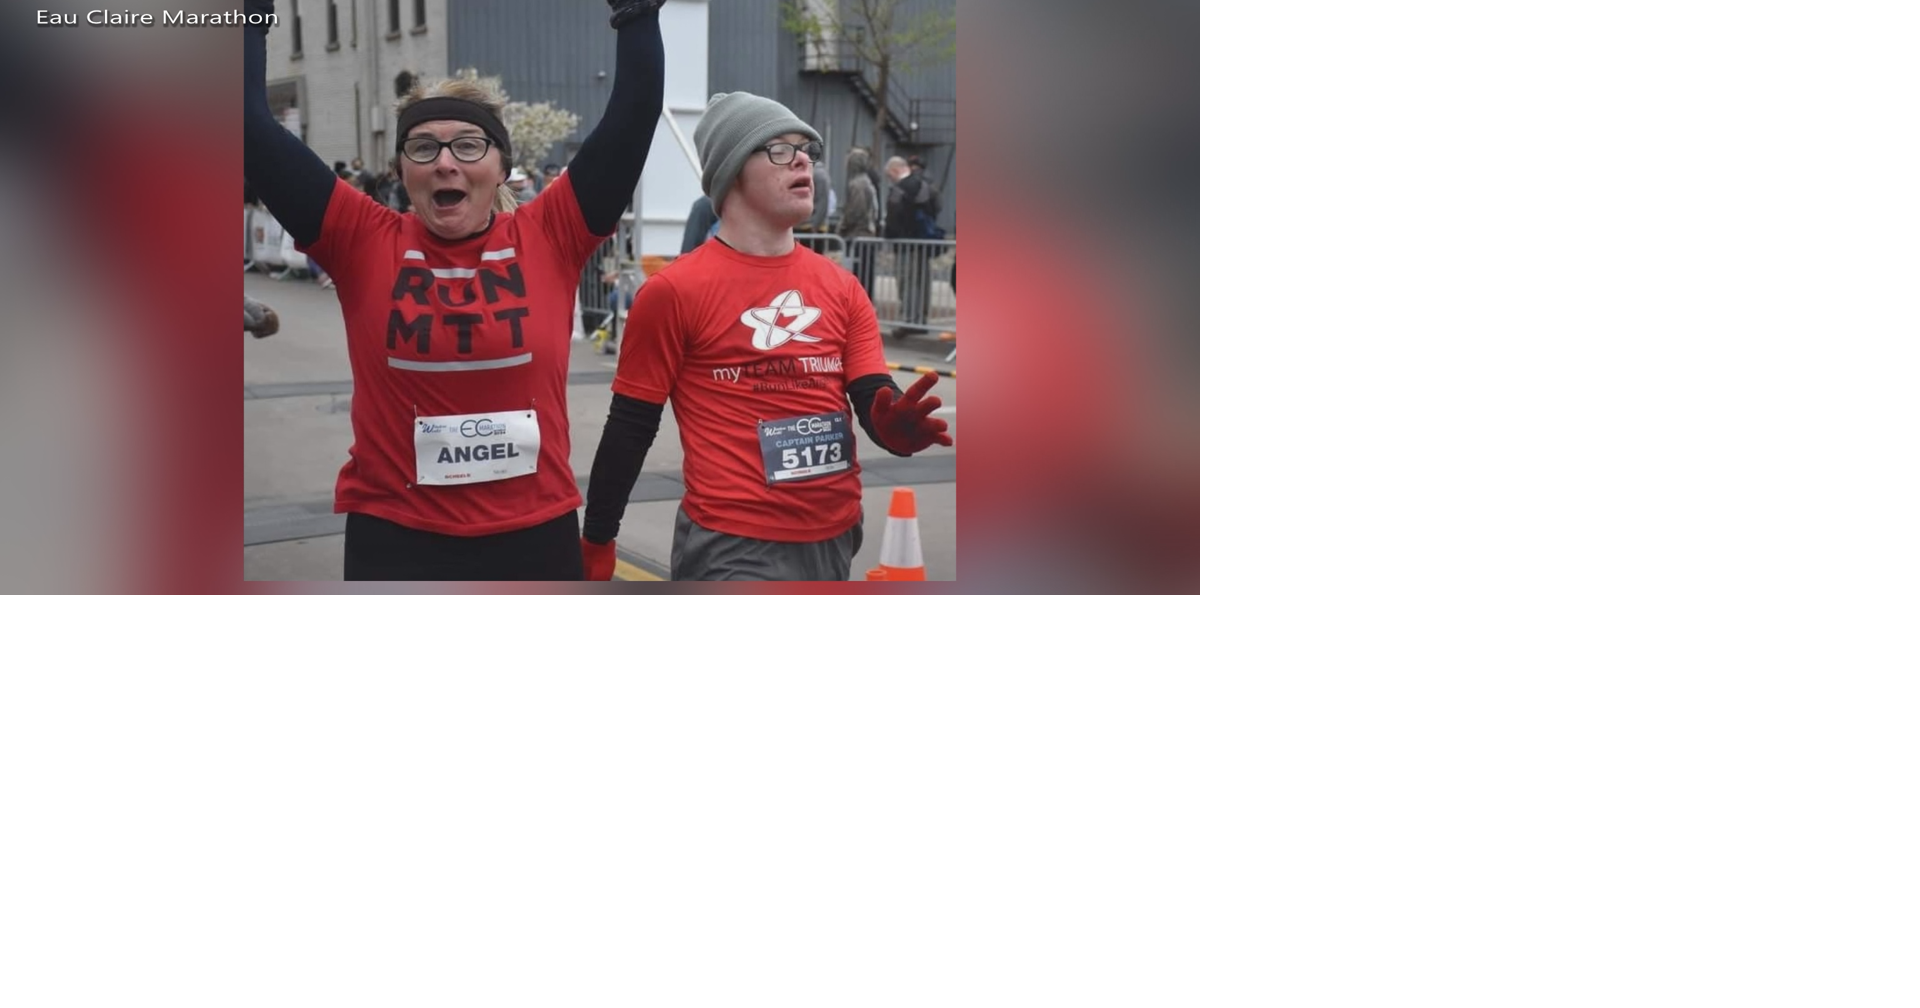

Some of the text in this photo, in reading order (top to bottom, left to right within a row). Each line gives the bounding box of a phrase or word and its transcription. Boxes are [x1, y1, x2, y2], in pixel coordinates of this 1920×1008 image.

[392, 262, 527, 307] RUN
[386, 307, 530, 354] MTT
[437, 442, 520, 464] ANGEL
[775, 432, 844, 448] CAPTAIN PARKER
[782, 442, 842, 469] 5173
